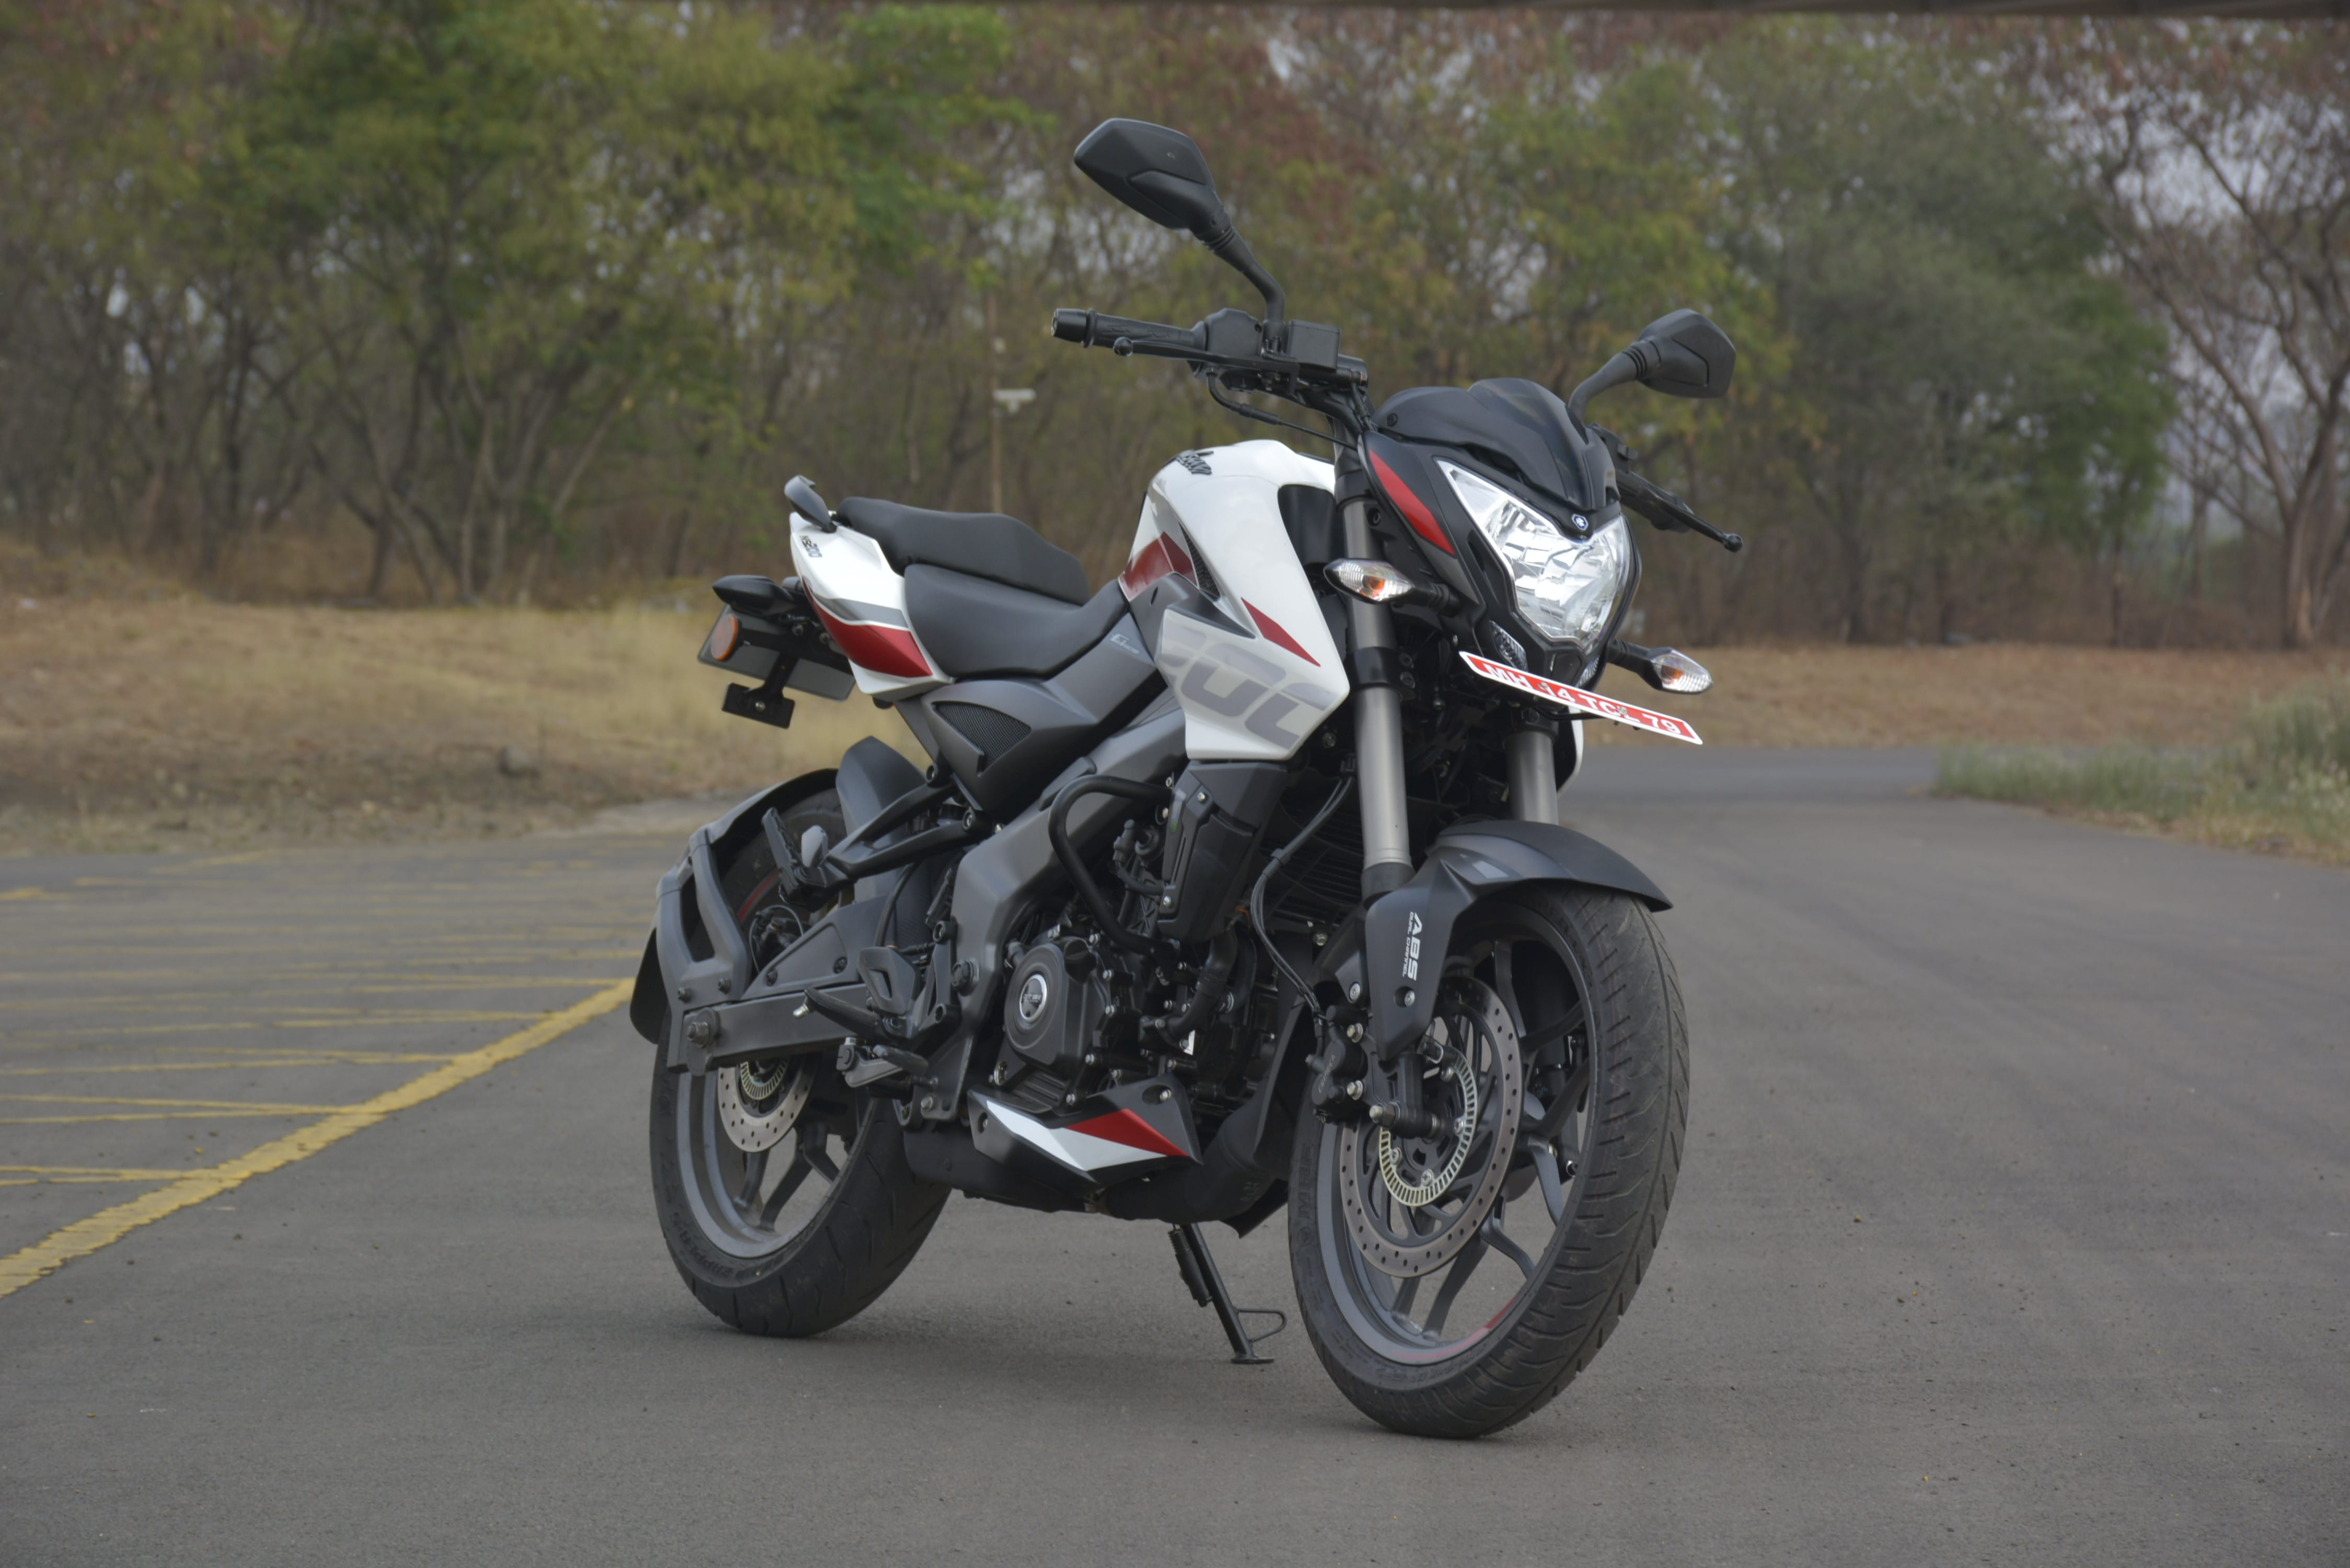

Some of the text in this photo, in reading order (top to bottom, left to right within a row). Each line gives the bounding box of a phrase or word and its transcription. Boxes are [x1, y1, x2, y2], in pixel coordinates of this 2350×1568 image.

[1482, 663, 1535, 690] MH
[1542, 682, 1576, 704] 14
[1642, 712, 1682, 734] 79
[1402, 936, 1411, 978] CHANNEL
[1407, 912, 1423, 982] ABS
